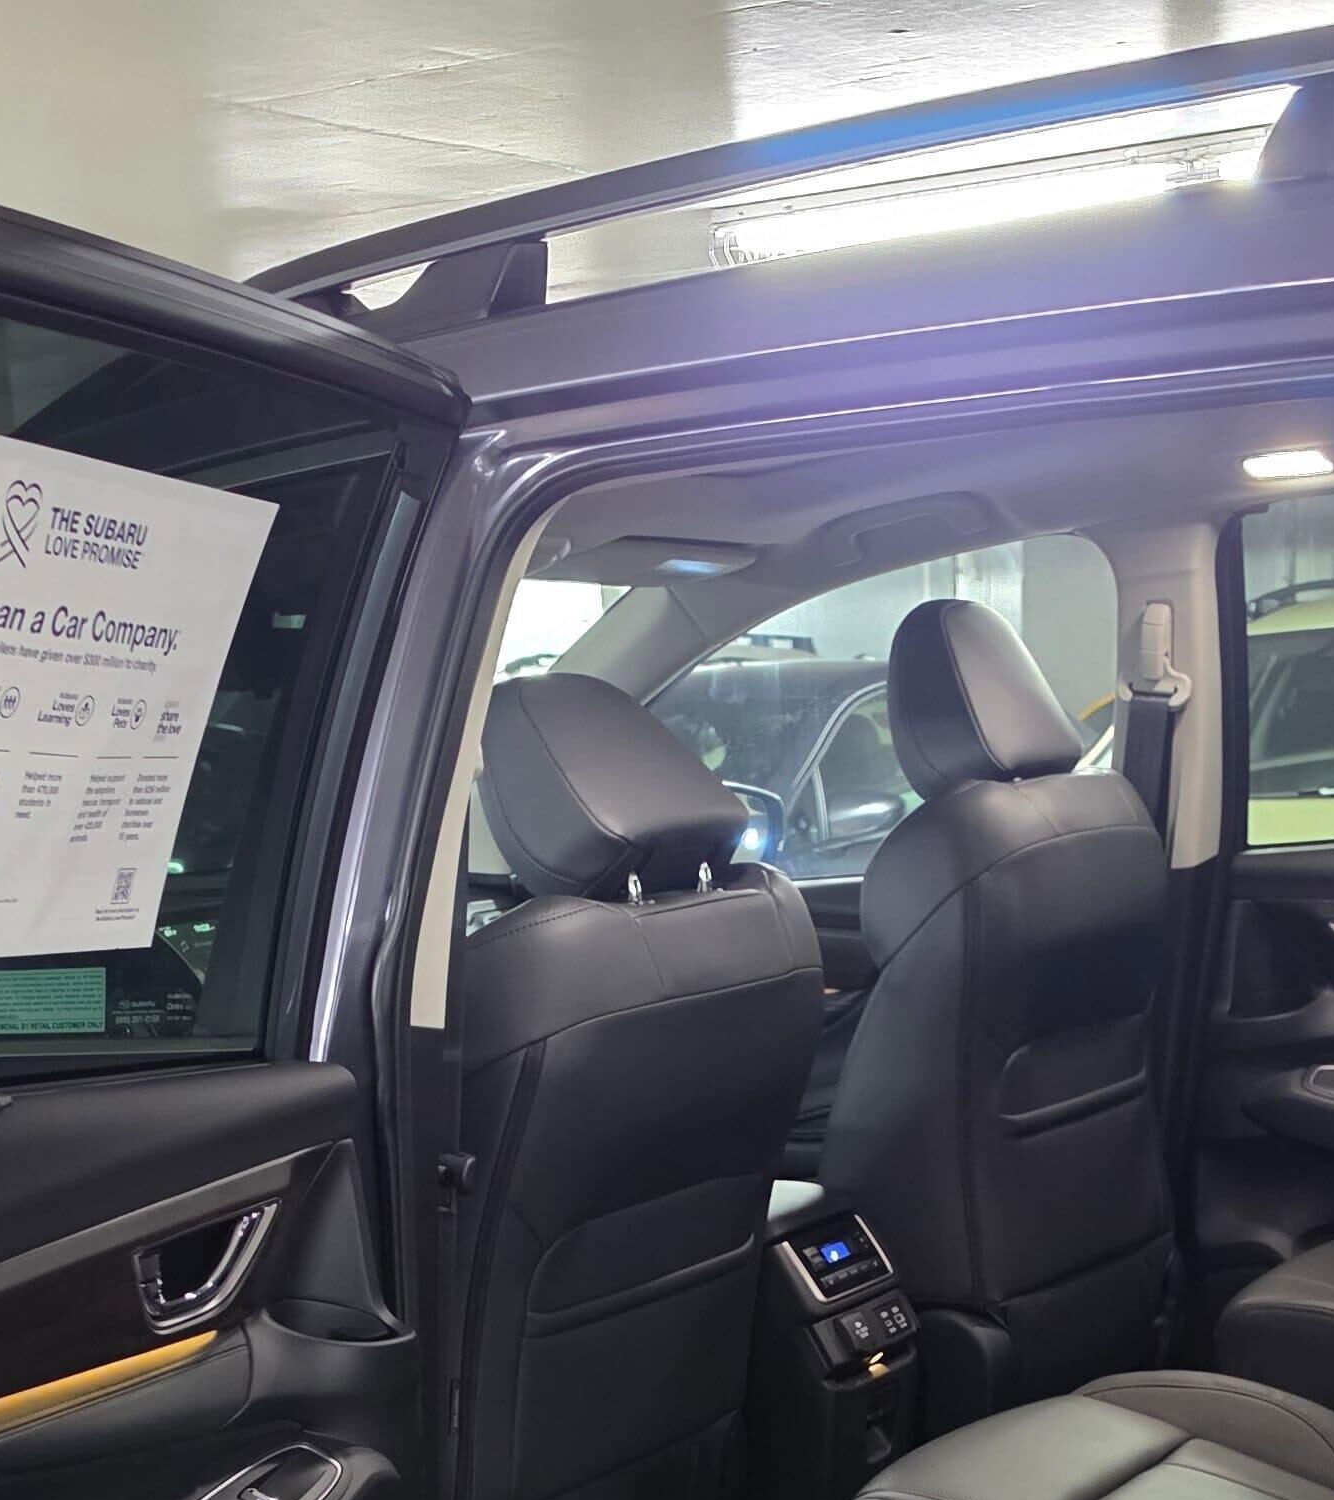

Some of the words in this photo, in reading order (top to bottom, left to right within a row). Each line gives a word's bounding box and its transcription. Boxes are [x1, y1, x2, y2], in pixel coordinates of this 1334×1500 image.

[51, 507, 81, 534] THE
[83, 514, 148, 546] SUBARU
[44, 534, 79, 560] LOVE
[80, 541, 141, 570] PROMISE
[30, 611, 45, 635] a
[51, 605, 88, 640] Car
[19, 645, 39, 658] have
[39, 649, 64, 663] given
[64, 653, 83, 664] over
[52, 699, 75, 713] Loves
[111, 704, 131, 718] Loves
[37, 709, 72, 728] Learning
[113, 717, 128, 729] Pets
[160, 710, 179, 722] share
[21, 1022, 29, 1030] BY
[30, 1022, 50, 1030] RETAIL
[51, 1021, 86, 1030] CUSTOMER
[86, 1021, 103, 1029] ONLY
